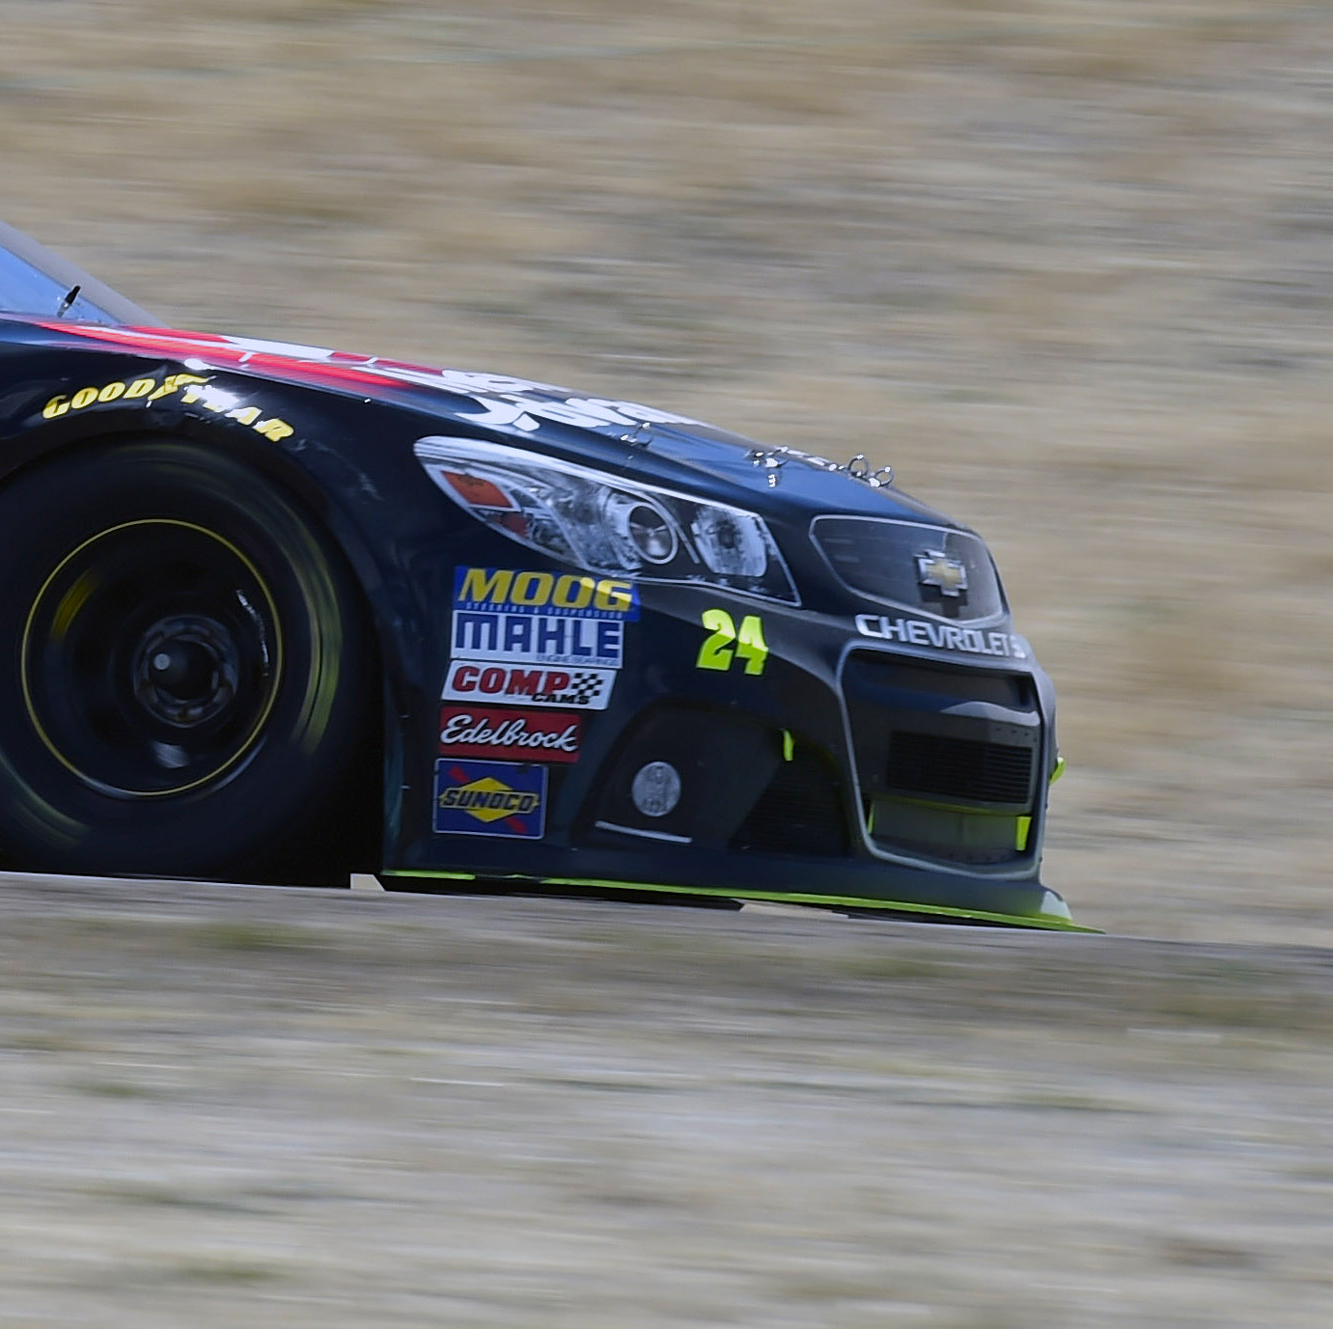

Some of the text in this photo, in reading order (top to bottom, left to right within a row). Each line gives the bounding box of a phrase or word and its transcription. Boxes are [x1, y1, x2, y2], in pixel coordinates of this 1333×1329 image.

[457, 568, 633, 612] MOOG
[455, 612, 621, 659] MAHLE
[696, 608, 770, 676] 24
[855, 613, 1010, 657] CHEVROLET
[451, 665, 591, 705] COMP CAMS
[440, 714, 580, 752] Edelbrock
[442, 788, 535, 812] SUNOCO
